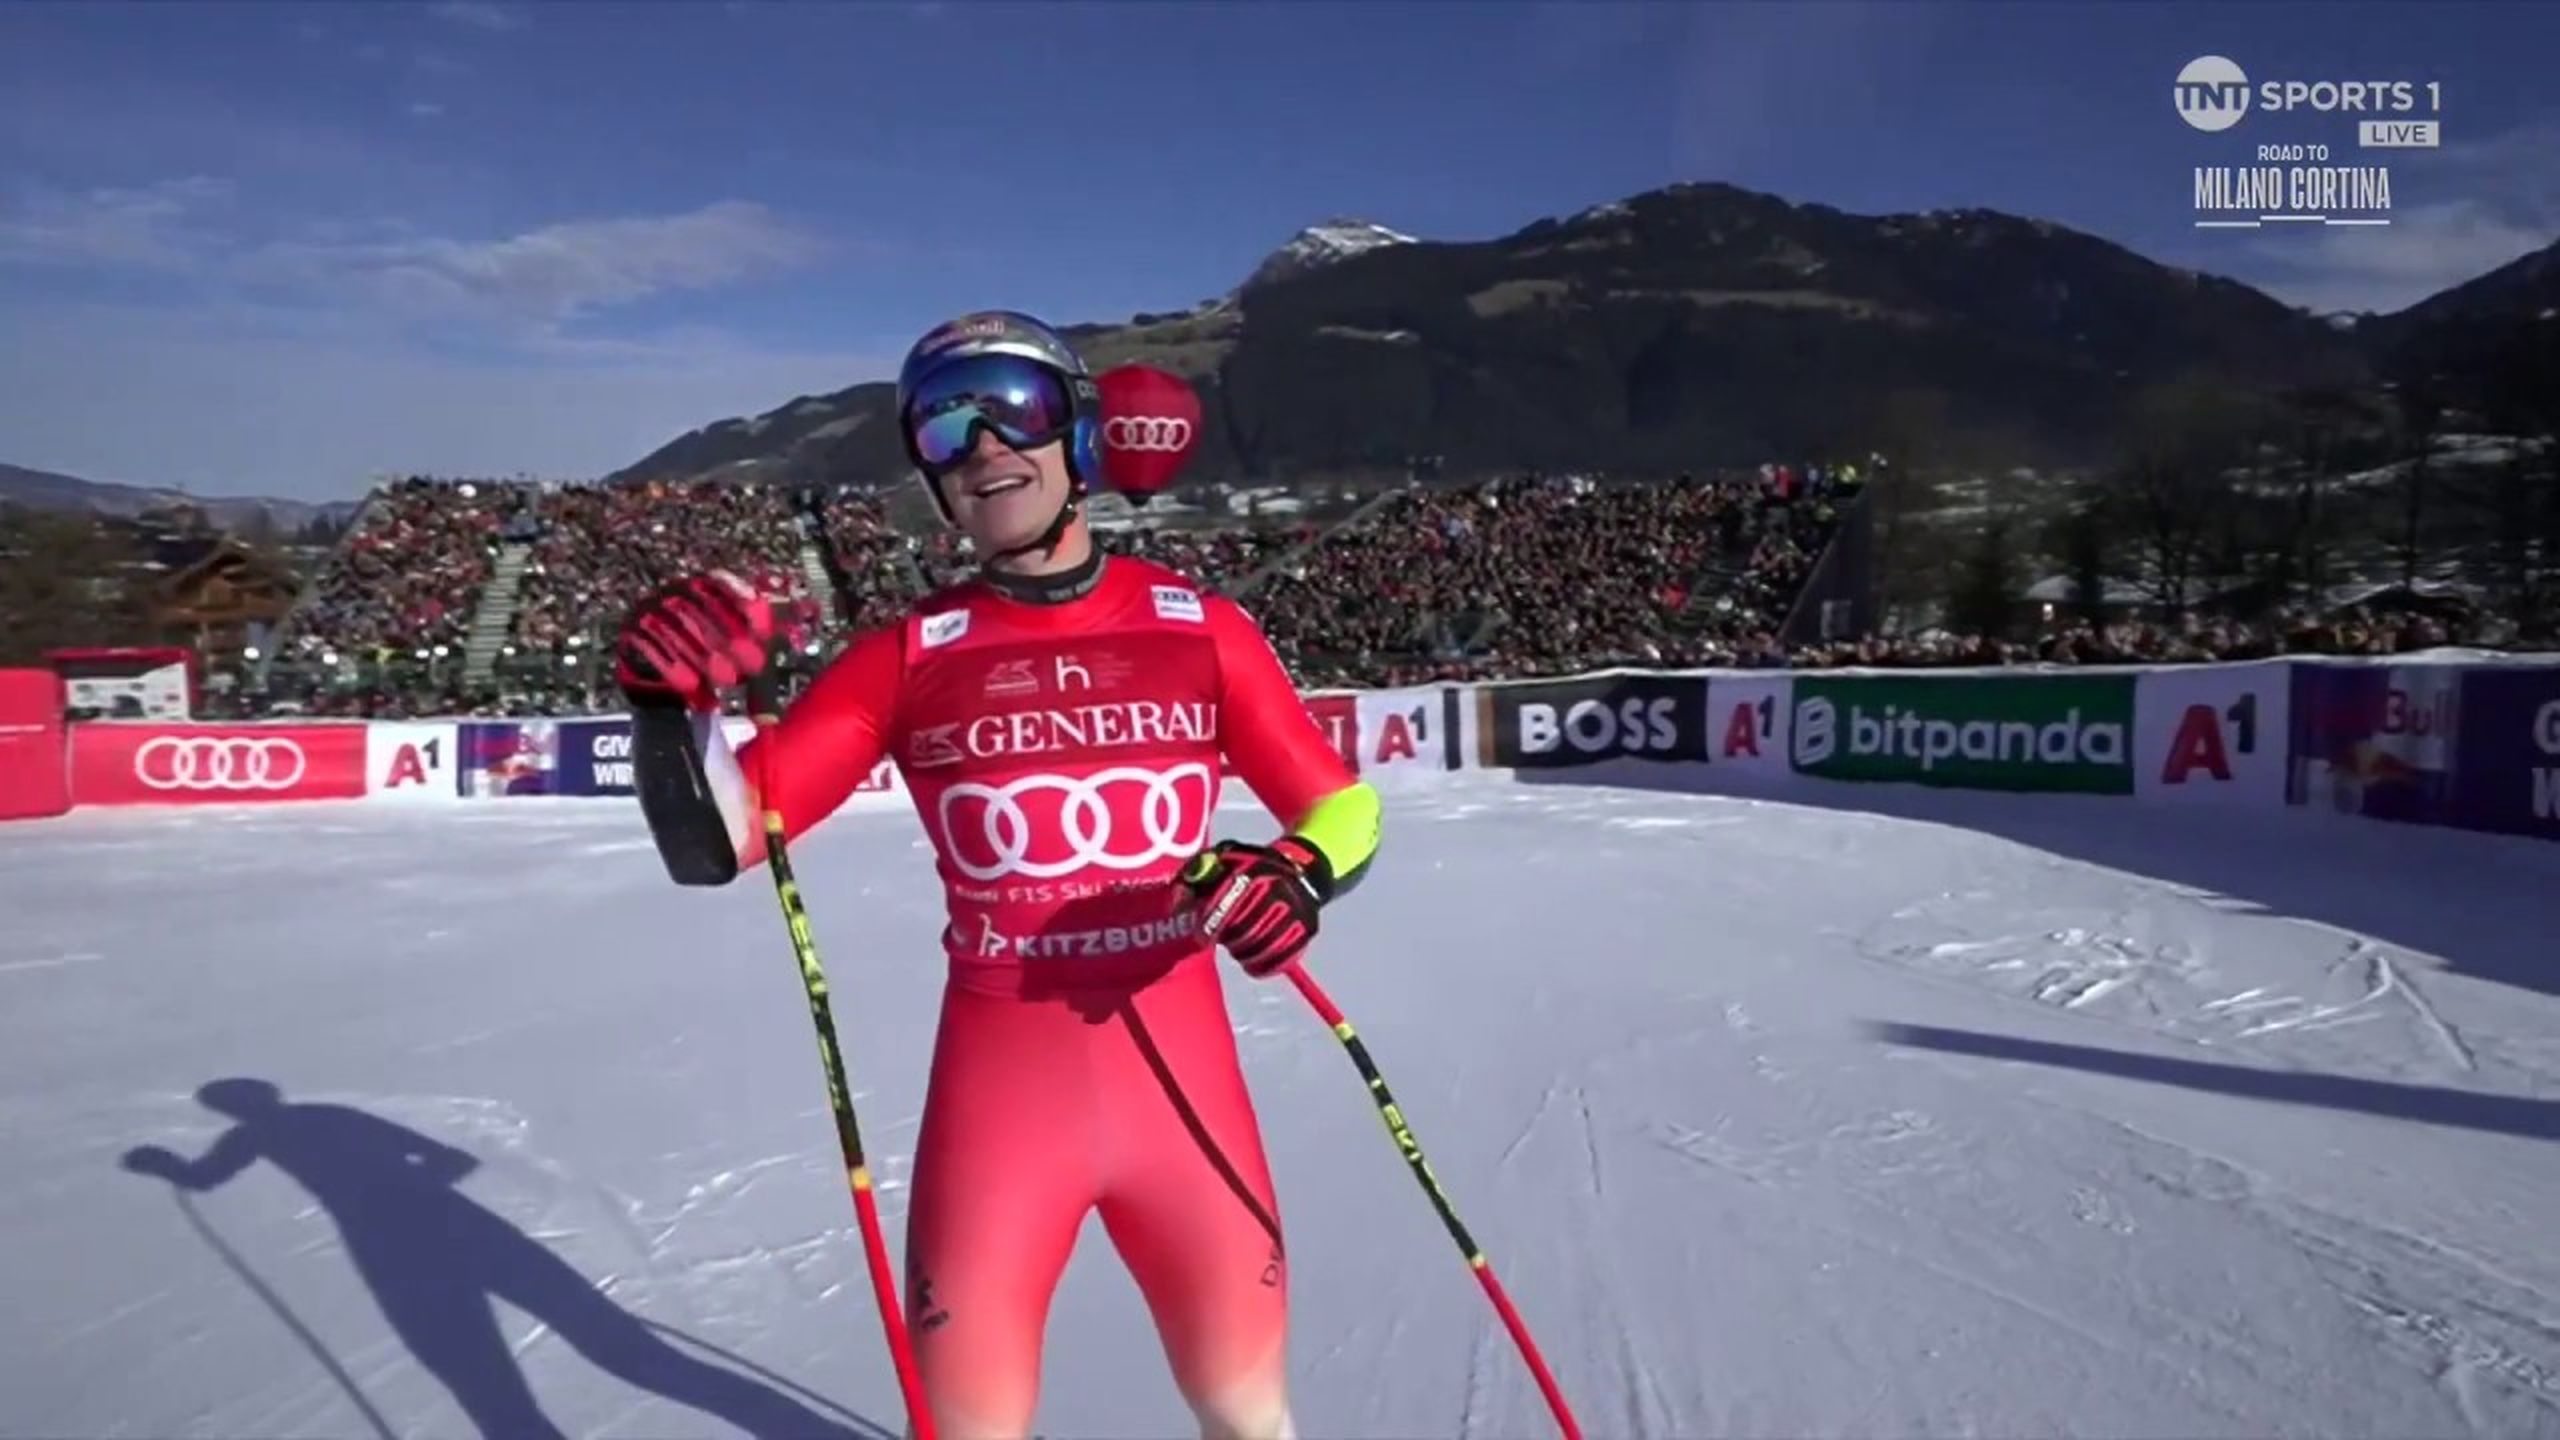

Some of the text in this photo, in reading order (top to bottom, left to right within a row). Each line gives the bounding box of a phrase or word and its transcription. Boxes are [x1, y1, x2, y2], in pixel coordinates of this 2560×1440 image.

[1376, 705, 1427, 764] A1
[1518, 697, 1678, 754] BOSS
[1724, 695, 1775, 757] A1
[1850, 704, 2124, 771] bitpanda
[2161, 692, 2257, 785] A1
[384, 736, 440, 788] A1
[1007, 883, 1053, 903] FIS
